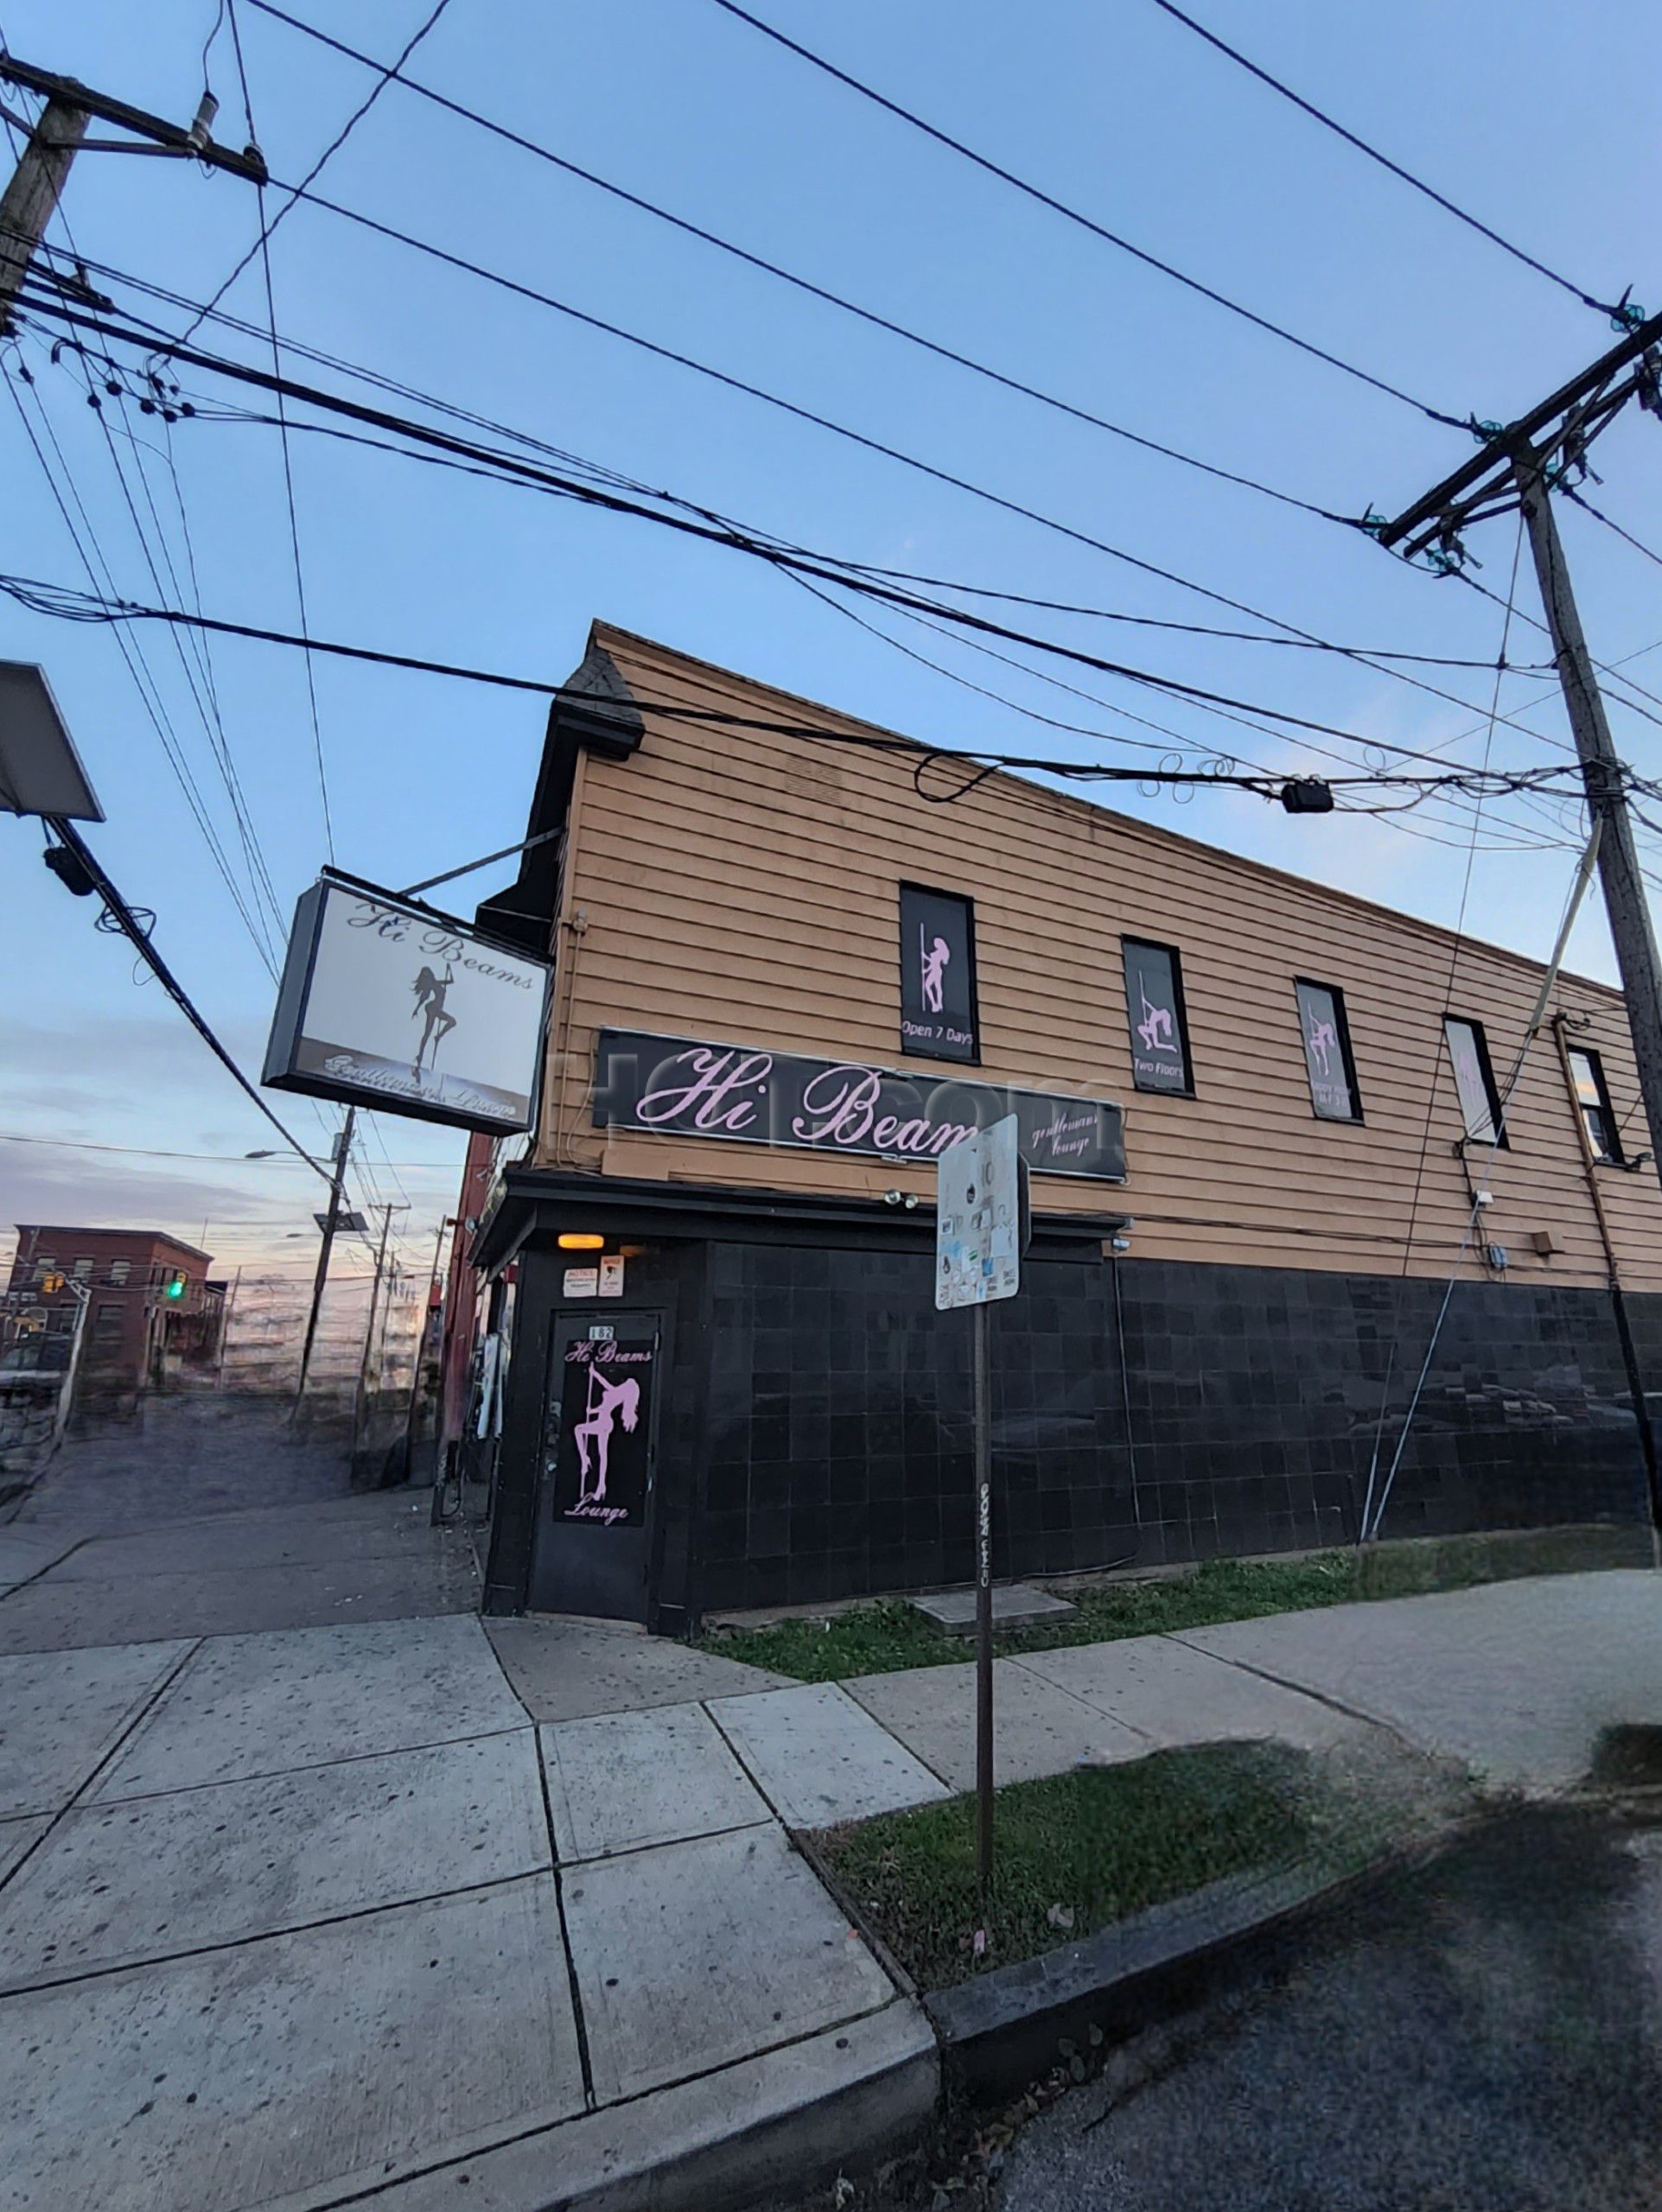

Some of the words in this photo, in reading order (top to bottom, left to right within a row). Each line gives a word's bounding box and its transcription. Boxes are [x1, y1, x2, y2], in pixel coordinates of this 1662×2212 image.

[347, 903, 411, 943] Hi
[418, 931, 533, 989] Beams
[901, 1020, 933, 1038] Open
[935, 1026, 944, 1039] 7
[946, 1027, 973, 1046] Days
[1134, 1058, 1154, 1072] Two
[1156, 1061, 1183, 1077] Floors
[636, 1048, 773, 1129] Hi
[793, 1065, 978, 1154] Beam
[1053, 1135, 1090, 1157] lounge
[591, 1327, 612, 1339] 182
[564, 1341, 595, 1363] Hi
[595, 1341, 653, 1363] Beams
[564, 1491, 629, 1526] Lounge
